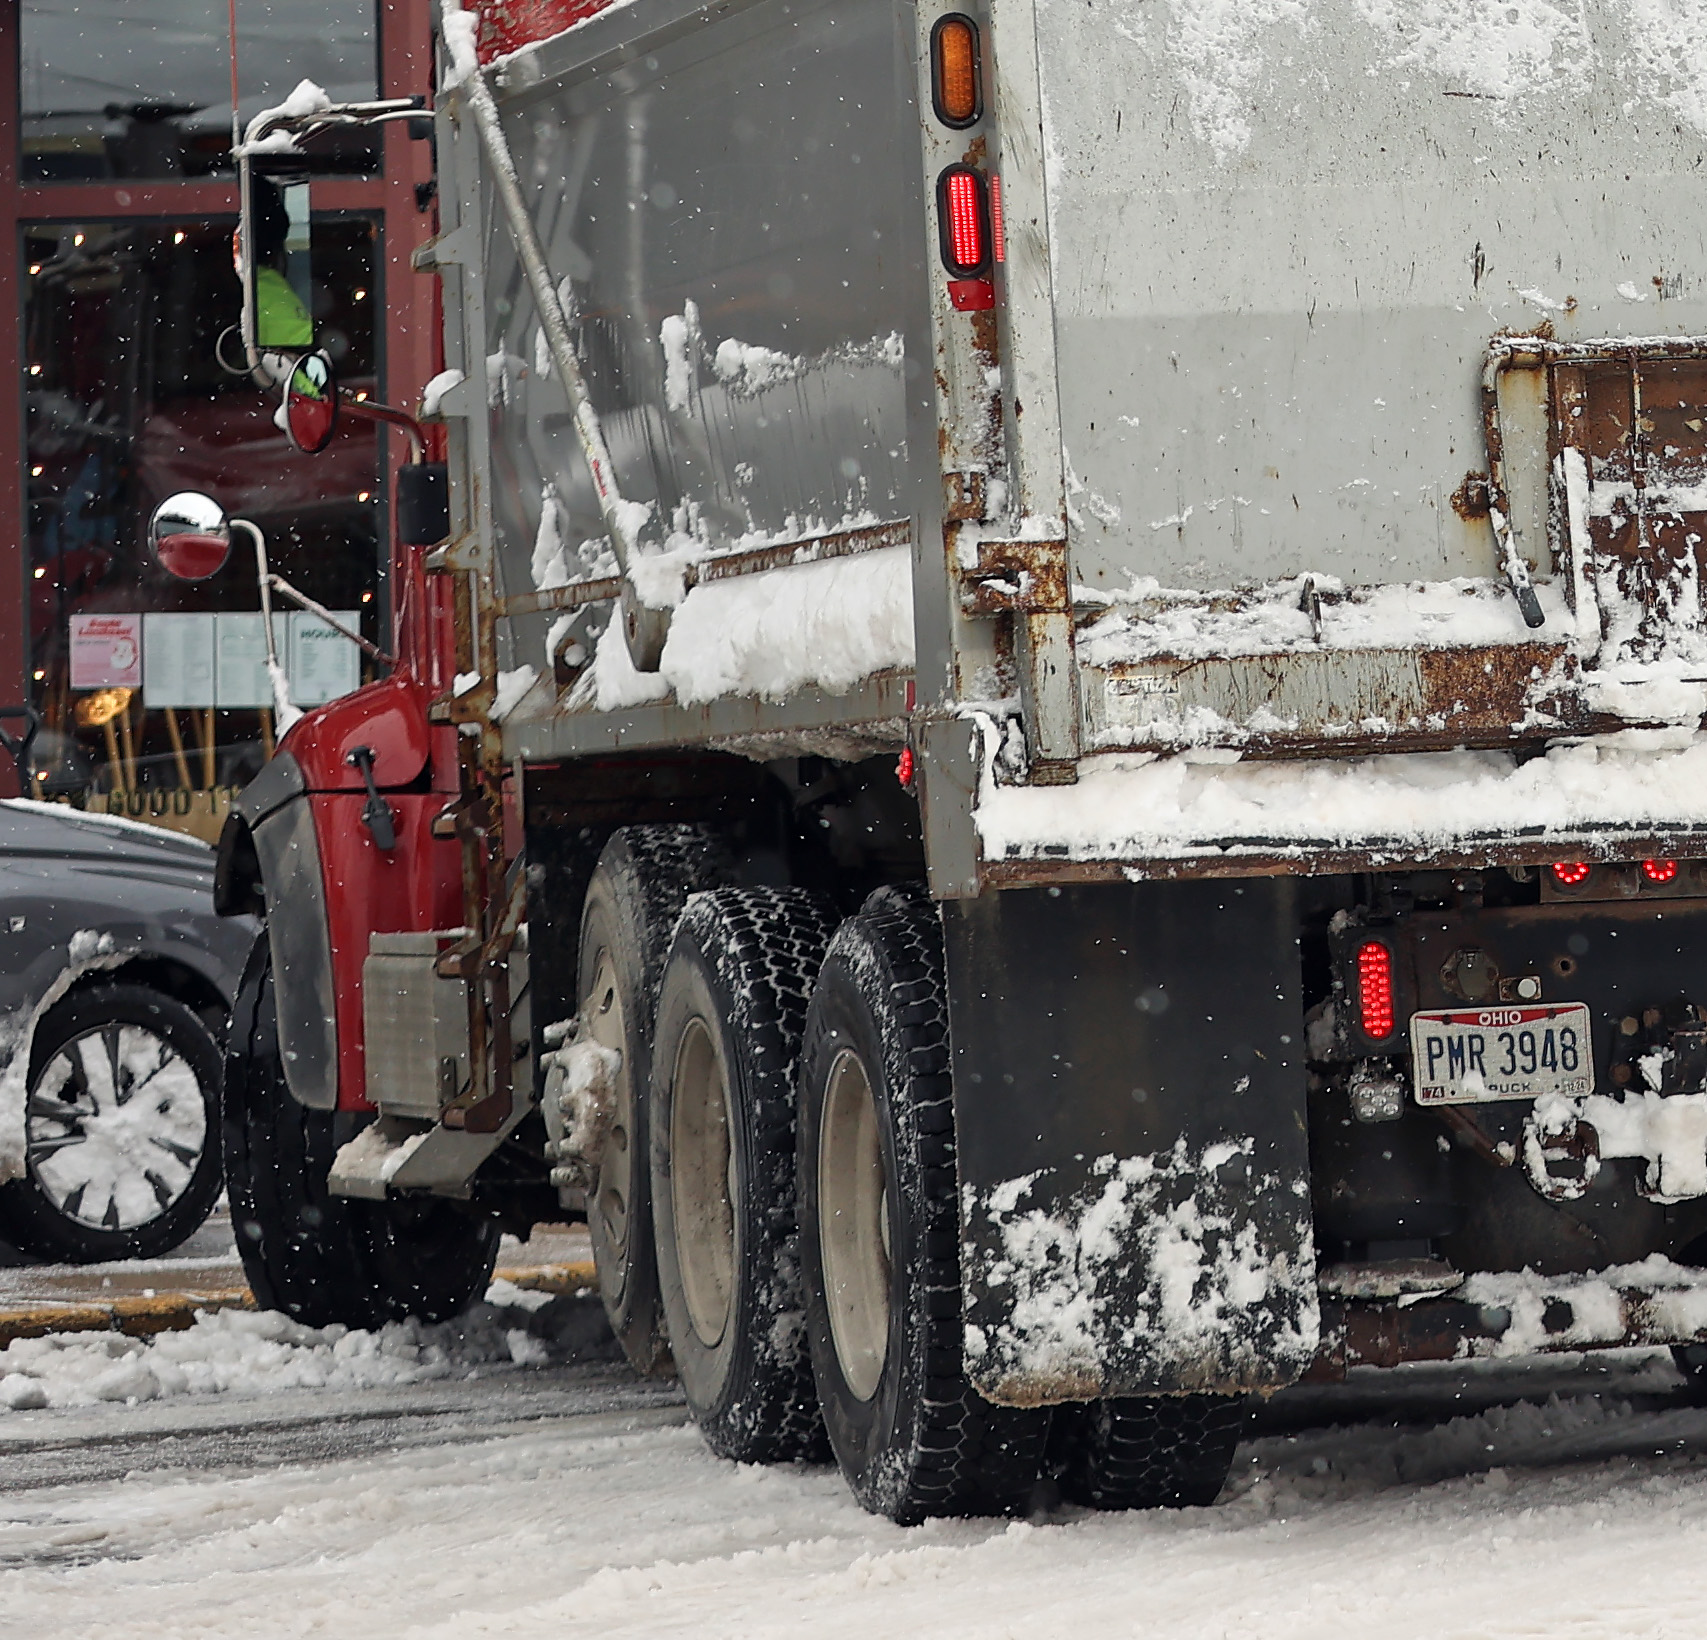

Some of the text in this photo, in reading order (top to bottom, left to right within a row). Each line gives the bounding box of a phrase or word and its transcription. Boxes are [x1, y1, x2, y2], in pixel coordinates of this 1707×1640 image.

[1478, 1011, 1522, 1026] OHIO
[1427, 1027, 1579, 1081] PMR 3948
